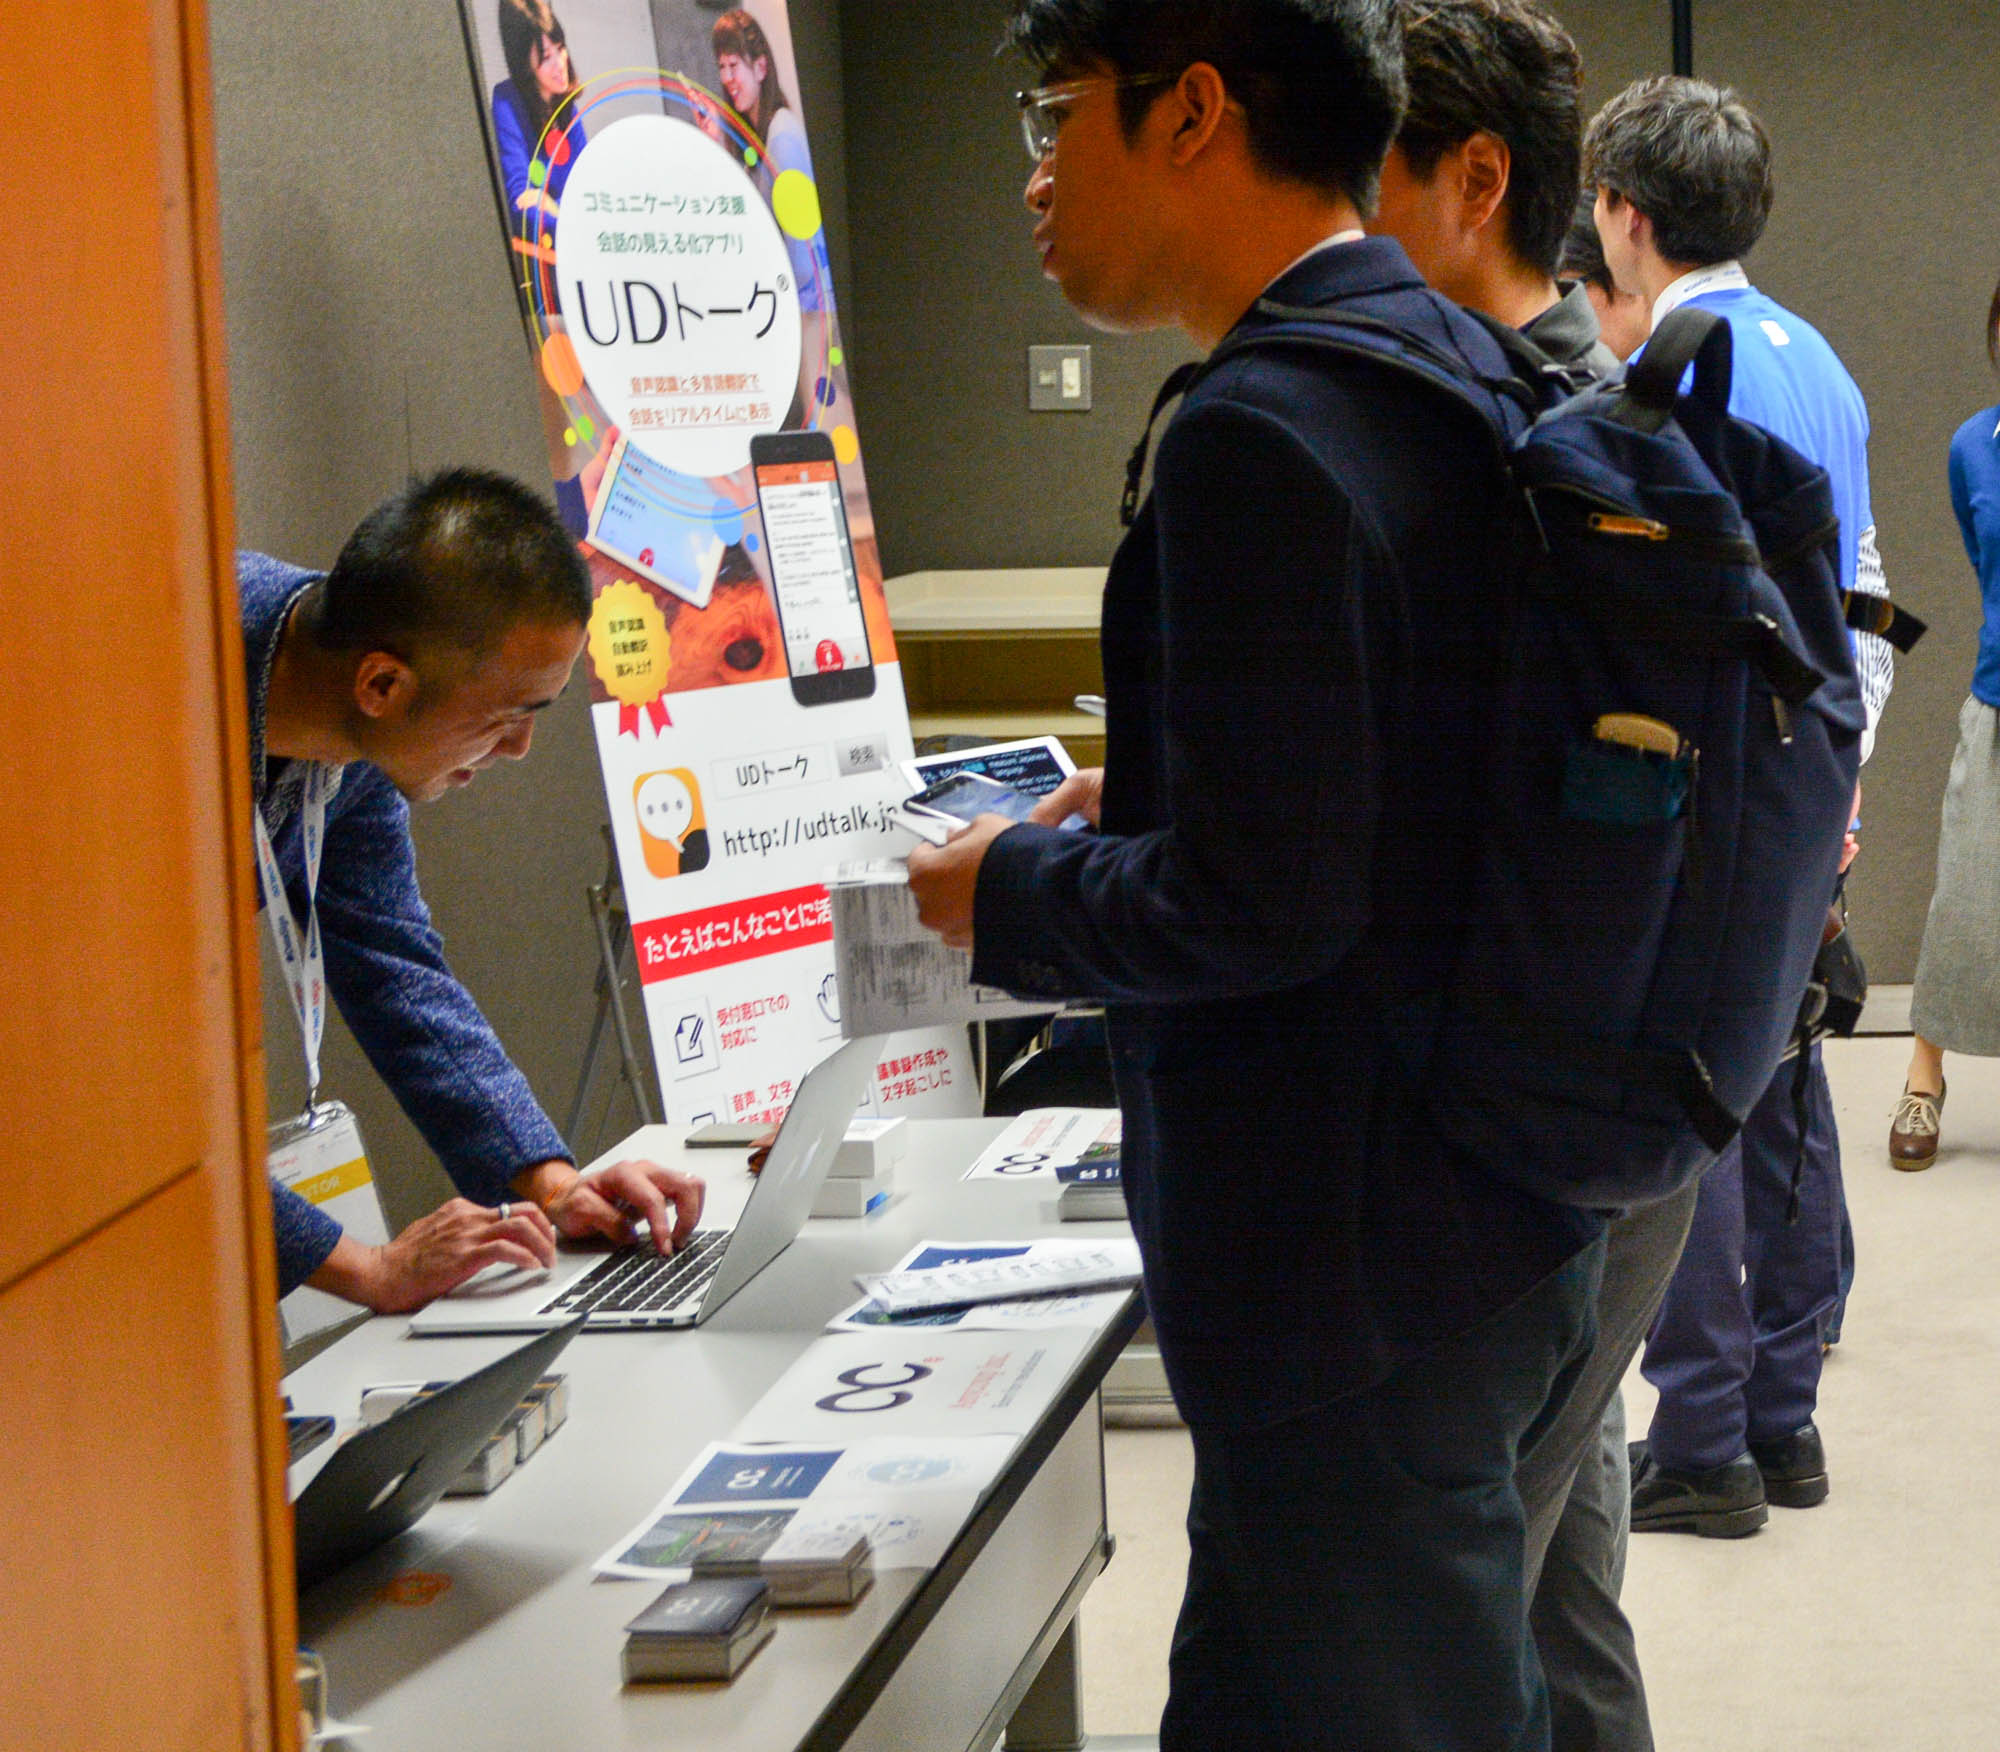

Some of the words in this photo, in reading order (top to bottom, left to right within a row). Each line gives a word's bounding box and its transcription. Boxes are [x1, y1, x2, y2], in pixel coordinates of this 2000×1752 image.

[583, 192, 746, 215] コミュニケーション支援
[597, 231, 743, 254] 会話の見える化アプリ
[736, 755, 808, 788] UDトーク
[717, 994, 790, 1028] 受付窓口での
[880, 1069, 952, 1103] 文字起こしに
